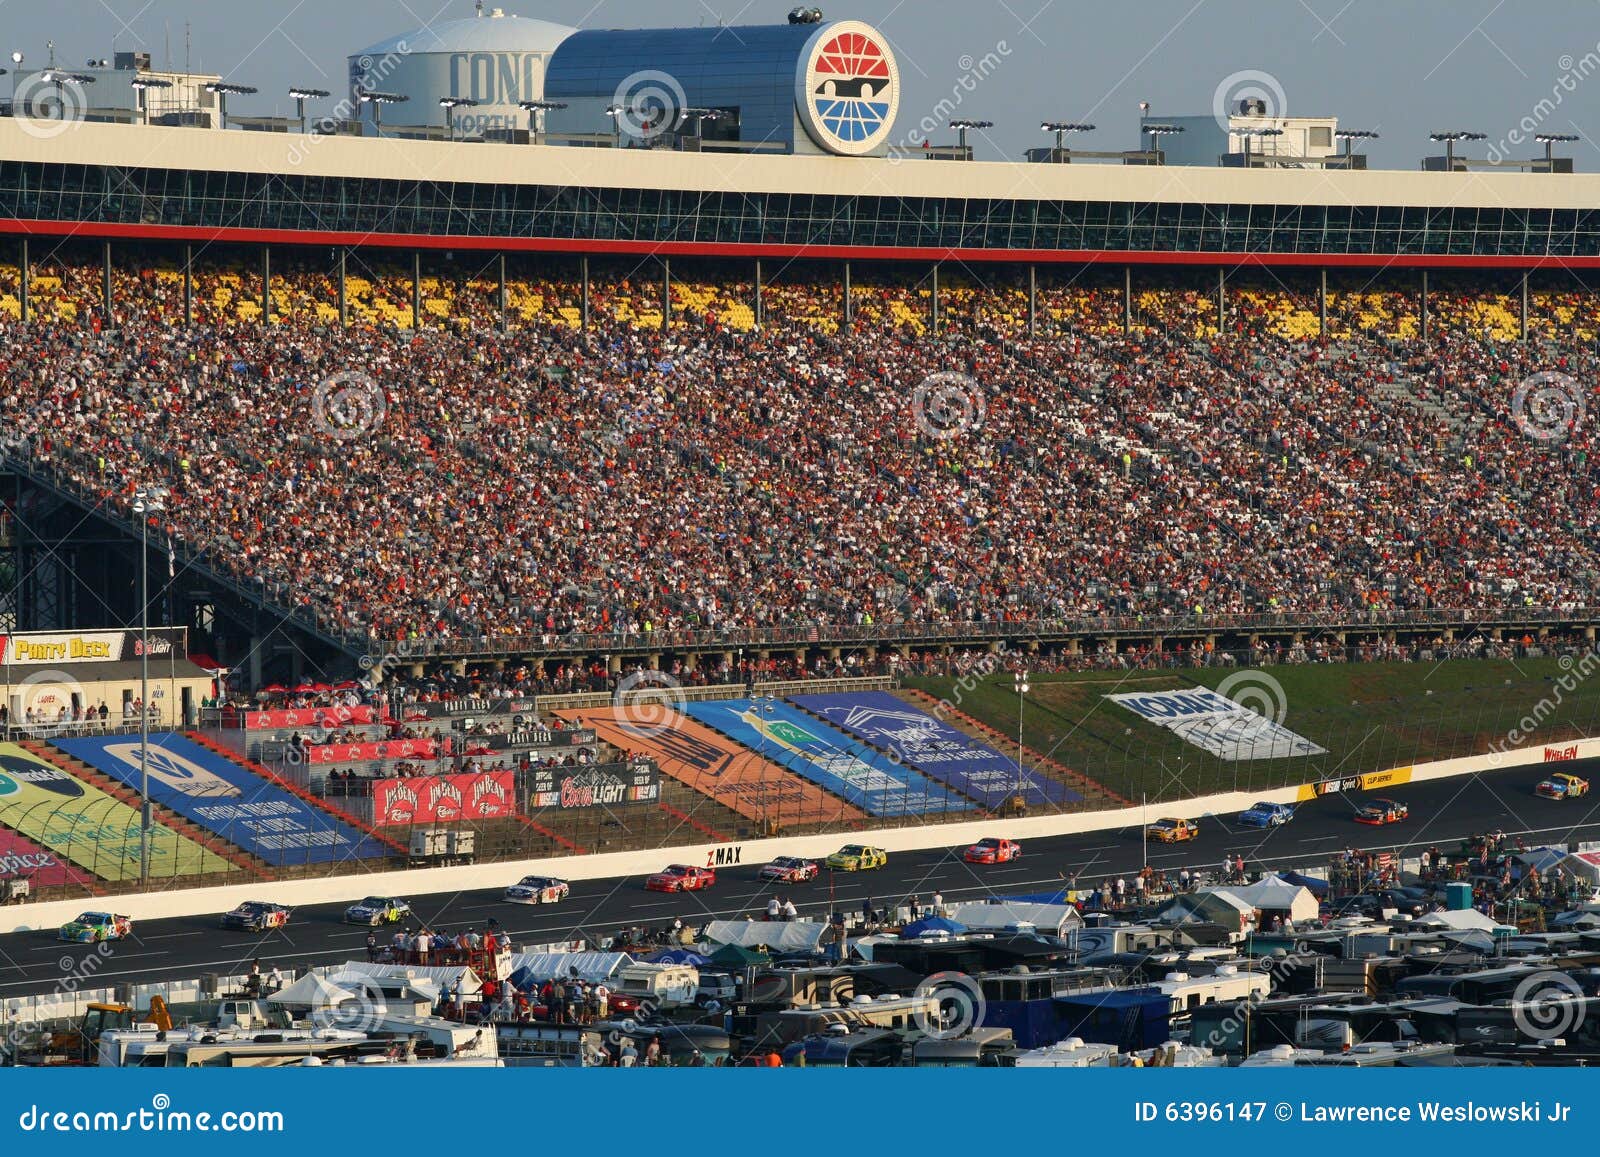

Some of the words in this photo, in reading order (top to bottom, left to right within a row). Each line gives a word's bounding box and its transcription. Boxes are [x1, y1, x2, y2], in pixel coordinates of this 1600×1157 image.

[15, 640, 67, 661] PARTY
[69, 637, 111, 659] DECK
[1544, 744, 1579, 762] WHELEN
[472, 782, 485, 807] JIM
[484, 774, 505, 804] BEAM
[592, 784, 627, 804] LIGHT
[1342, 778, 1356, 792] Sprint
